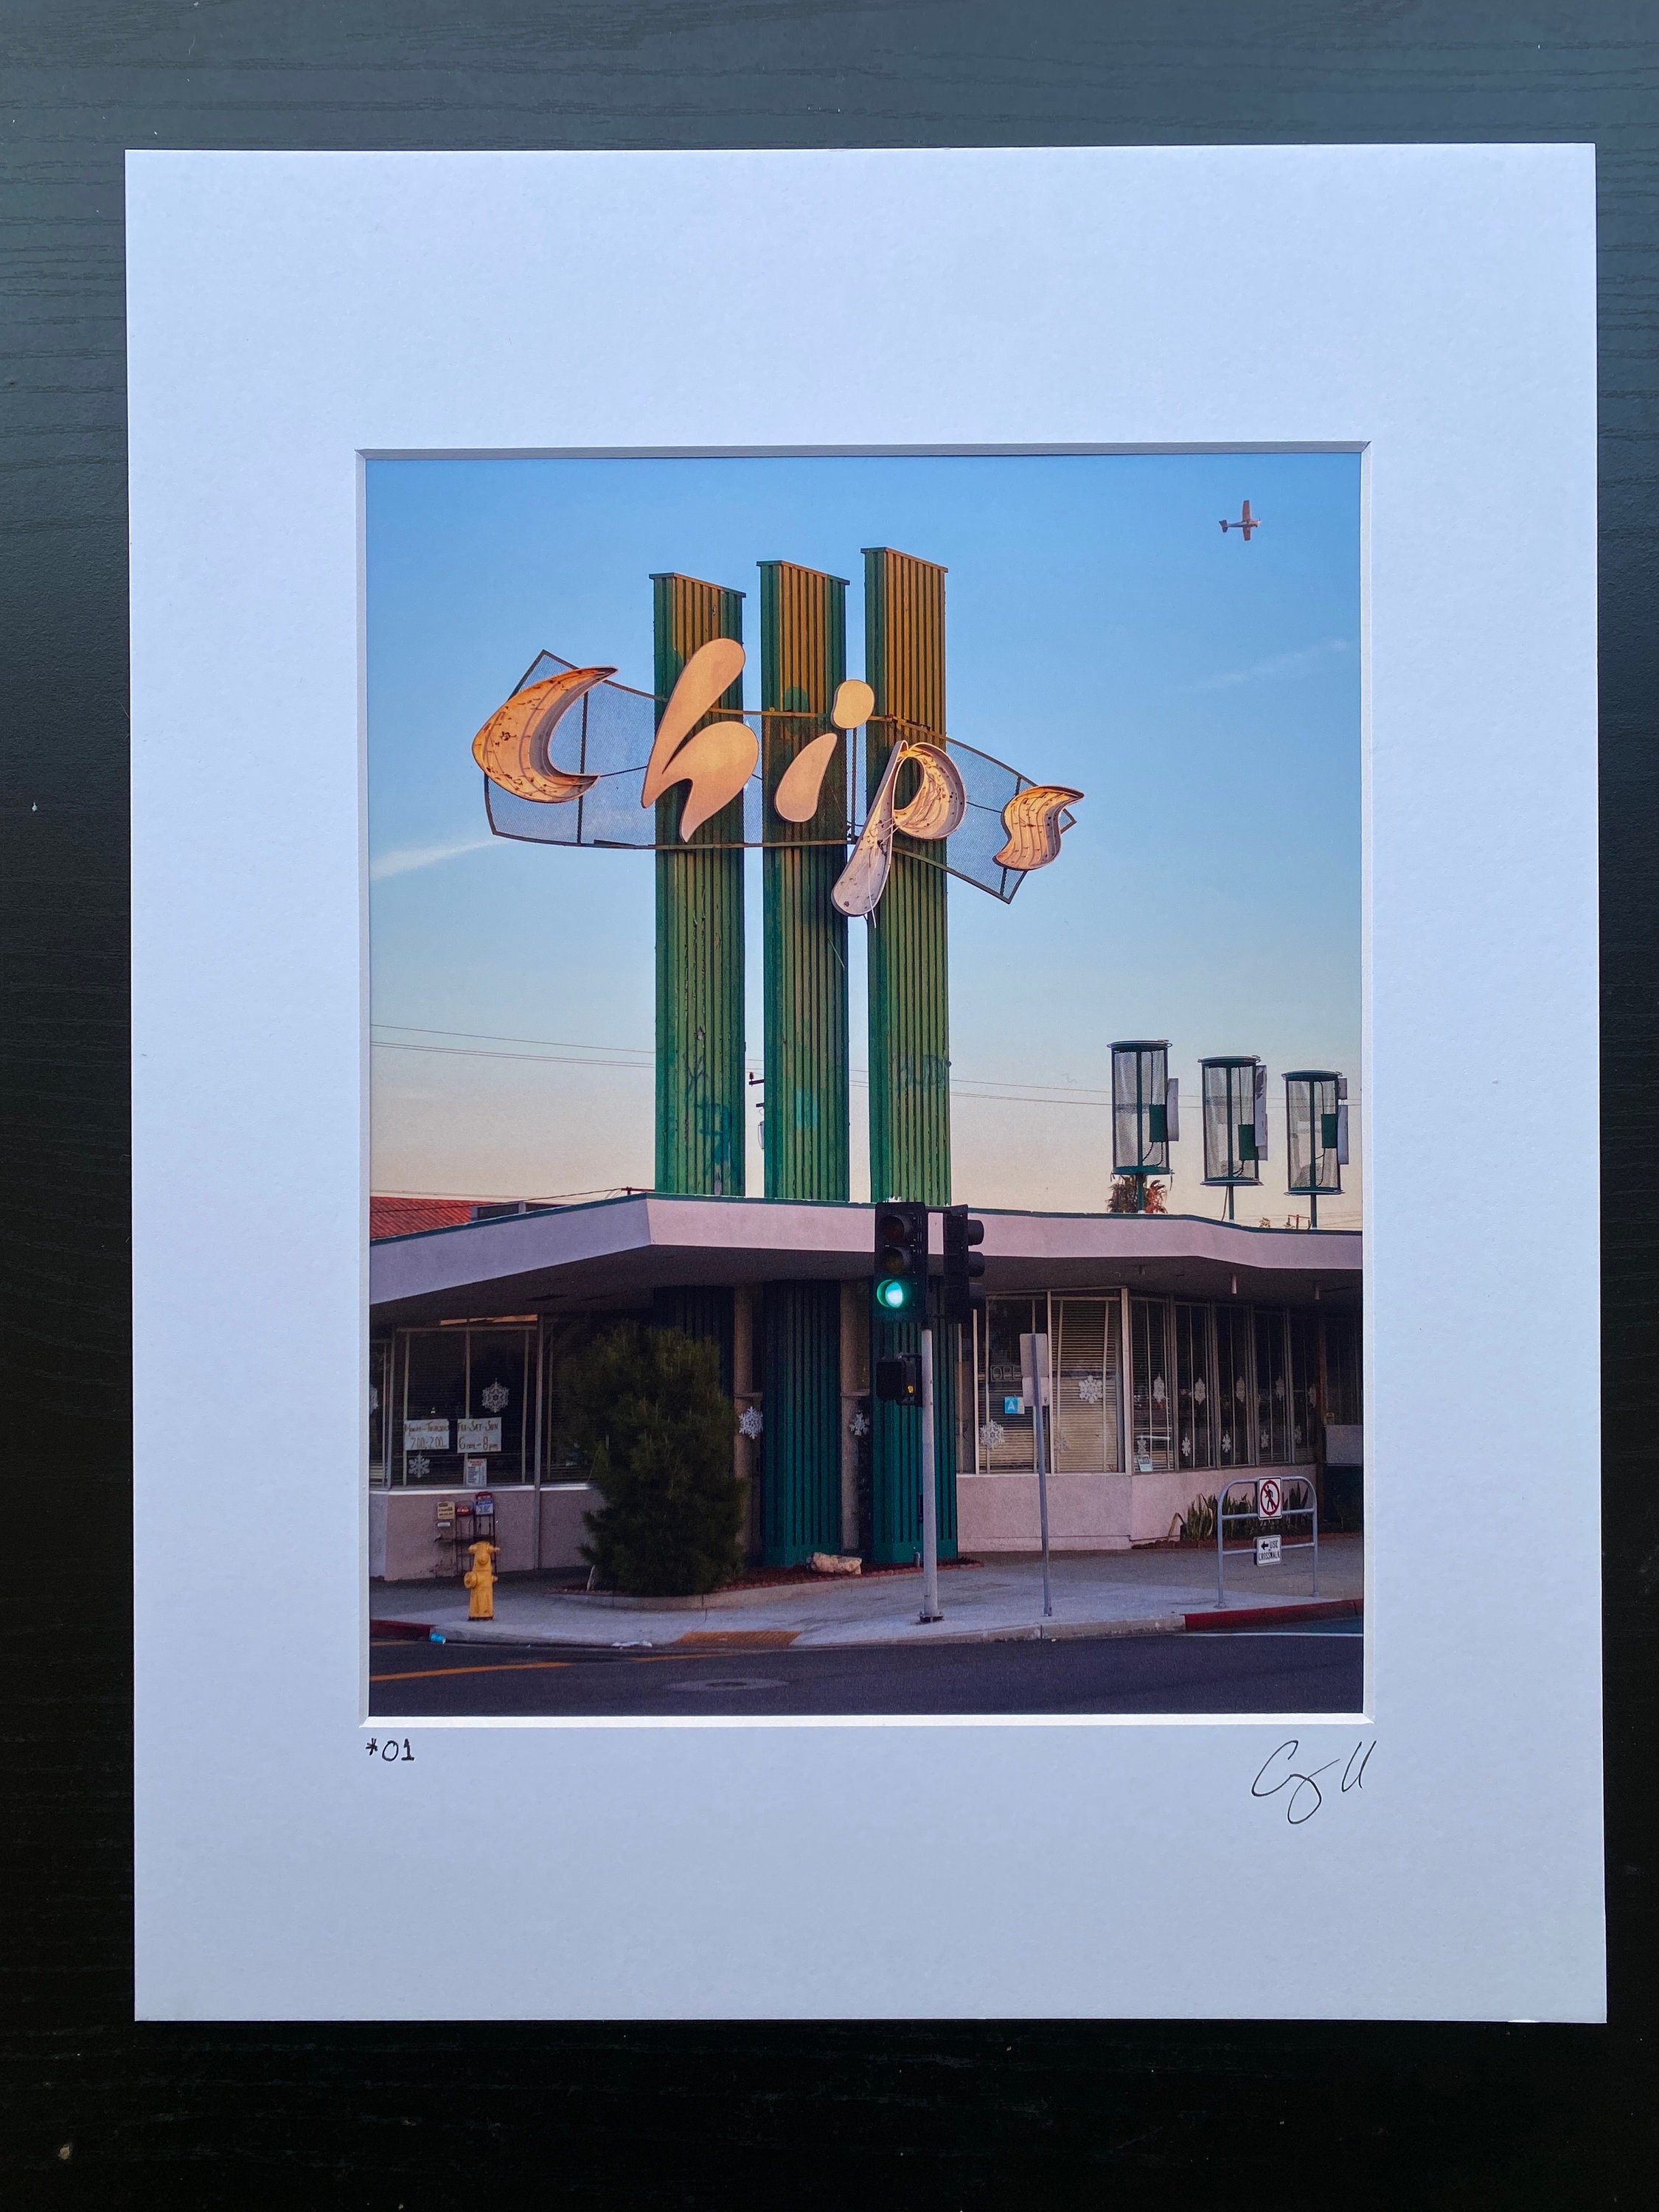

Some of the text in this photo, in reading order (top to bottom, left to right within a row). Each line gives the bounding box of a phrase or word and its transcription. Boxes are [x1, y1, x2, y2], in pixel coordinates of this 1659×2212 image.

[992, 1366, 1022, 1380] OPE
[1007, 1401, 1015, 1411] A
[1270, 1540, 1279, 1548] USE
